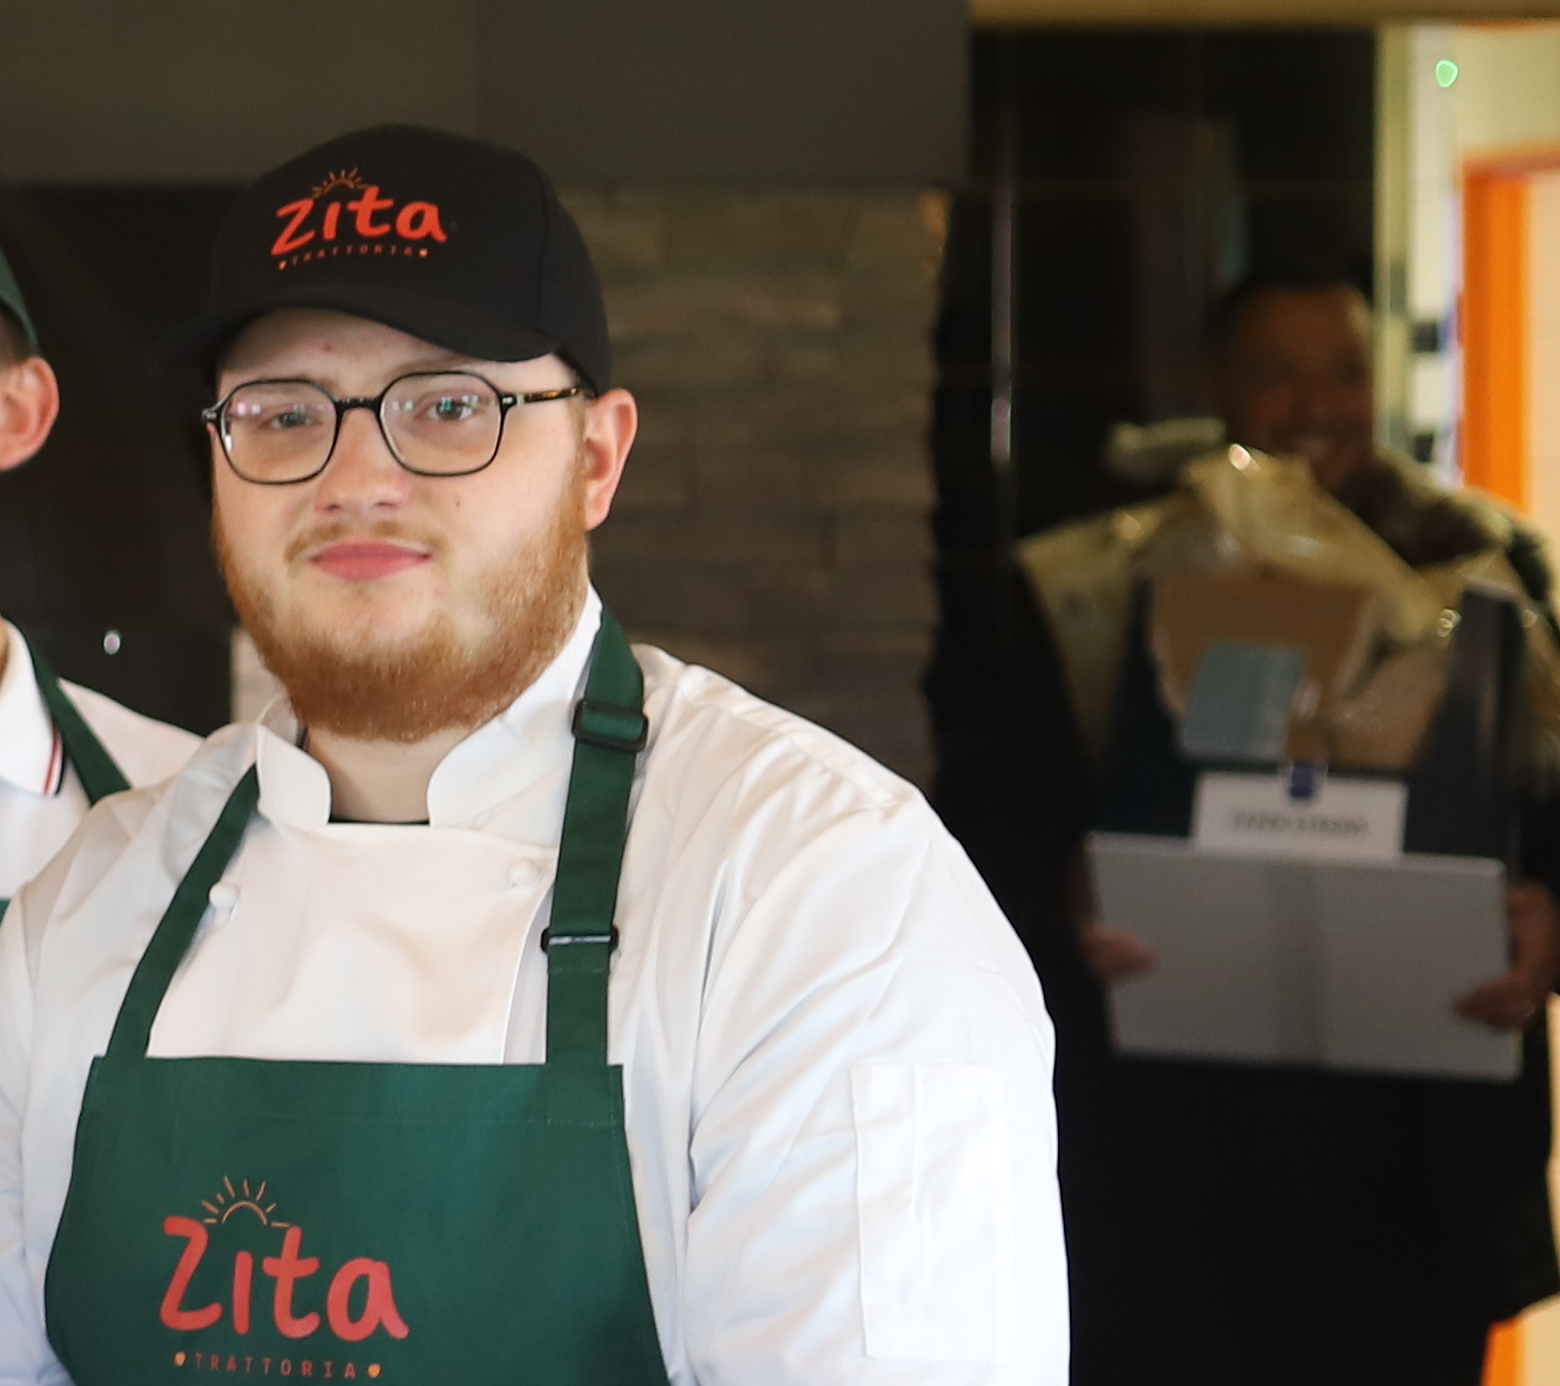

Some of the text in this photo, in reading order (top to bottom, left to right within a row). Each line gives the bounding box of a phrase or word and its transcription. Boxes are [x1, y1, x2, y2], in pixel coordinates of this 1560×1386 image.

[271, 185, 448, 256] Zita
[159, 1215, 411, 1342] Zita
[194, 1353, 357, 1380] TRATTORIA
